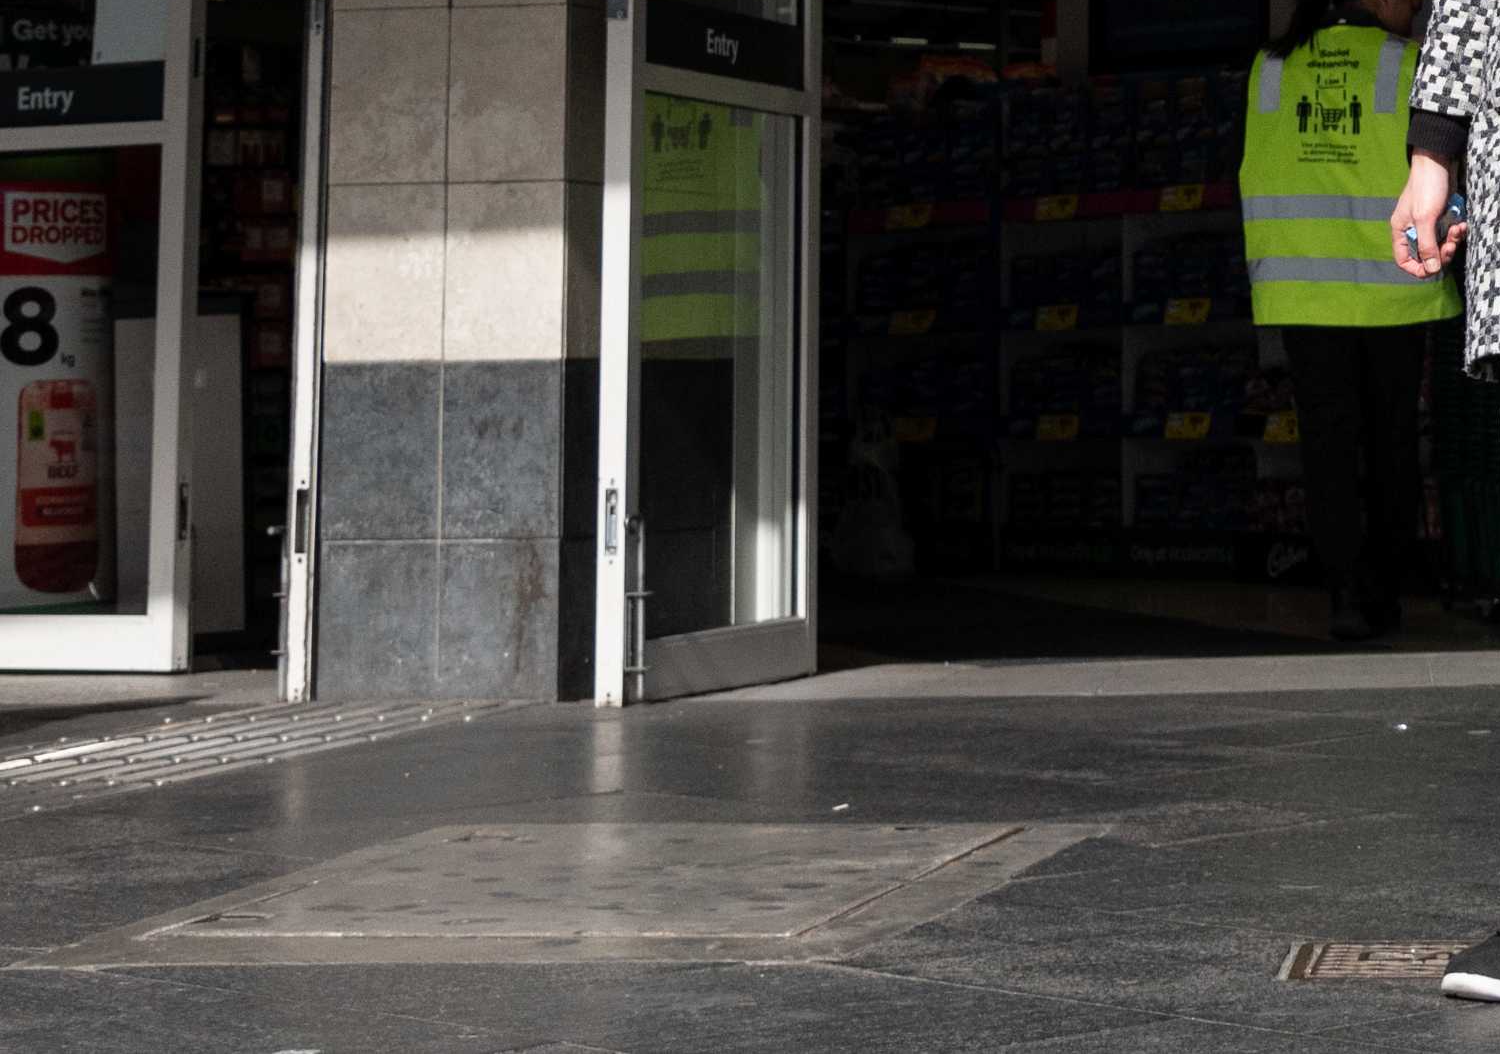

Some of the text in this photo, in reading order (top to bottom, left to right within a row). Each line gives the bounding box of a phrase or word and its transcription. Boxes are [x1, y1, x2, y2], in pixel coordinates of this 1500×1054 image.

[11, 18, 59, 43] Get
[705, 27, 740, 66] Entry
[17, 85, 76, 116] Entry
[12, 198, 105, 225] PRICES
[11, 225, 105, 245] DROPPED
[2, 286, 59, 366] 8
